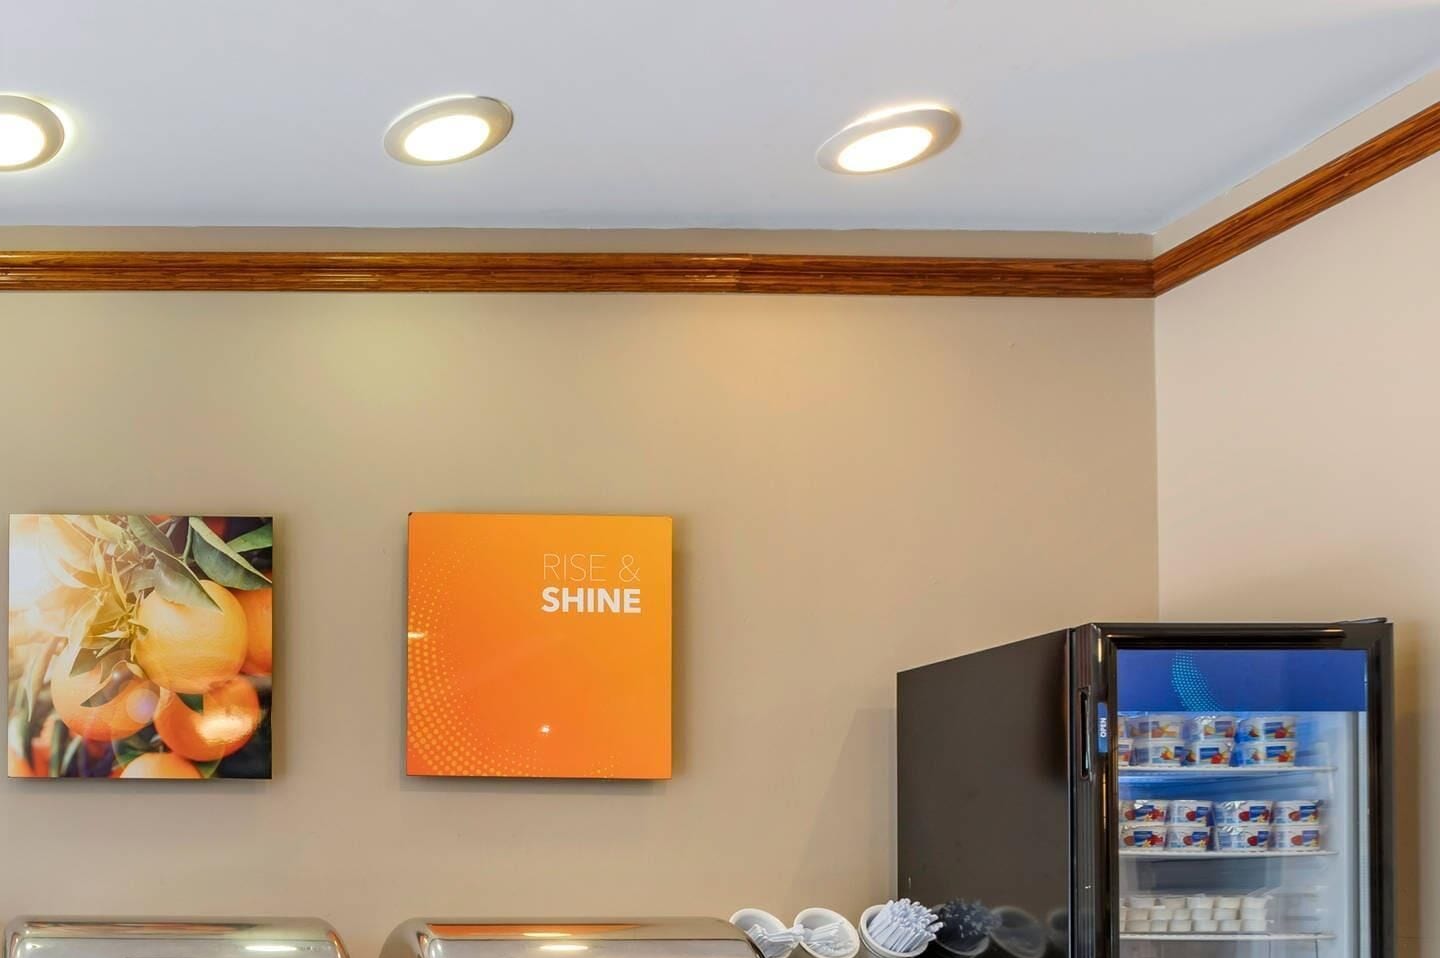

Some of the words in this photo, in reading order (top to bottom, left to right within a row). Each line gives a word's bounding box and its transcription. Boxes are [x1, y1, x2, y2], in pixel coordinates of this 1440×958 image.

[543, 553, 608, 582] RISE
[618, 554, 641, 583] &
[541, 586, 641, 613] SHINE
